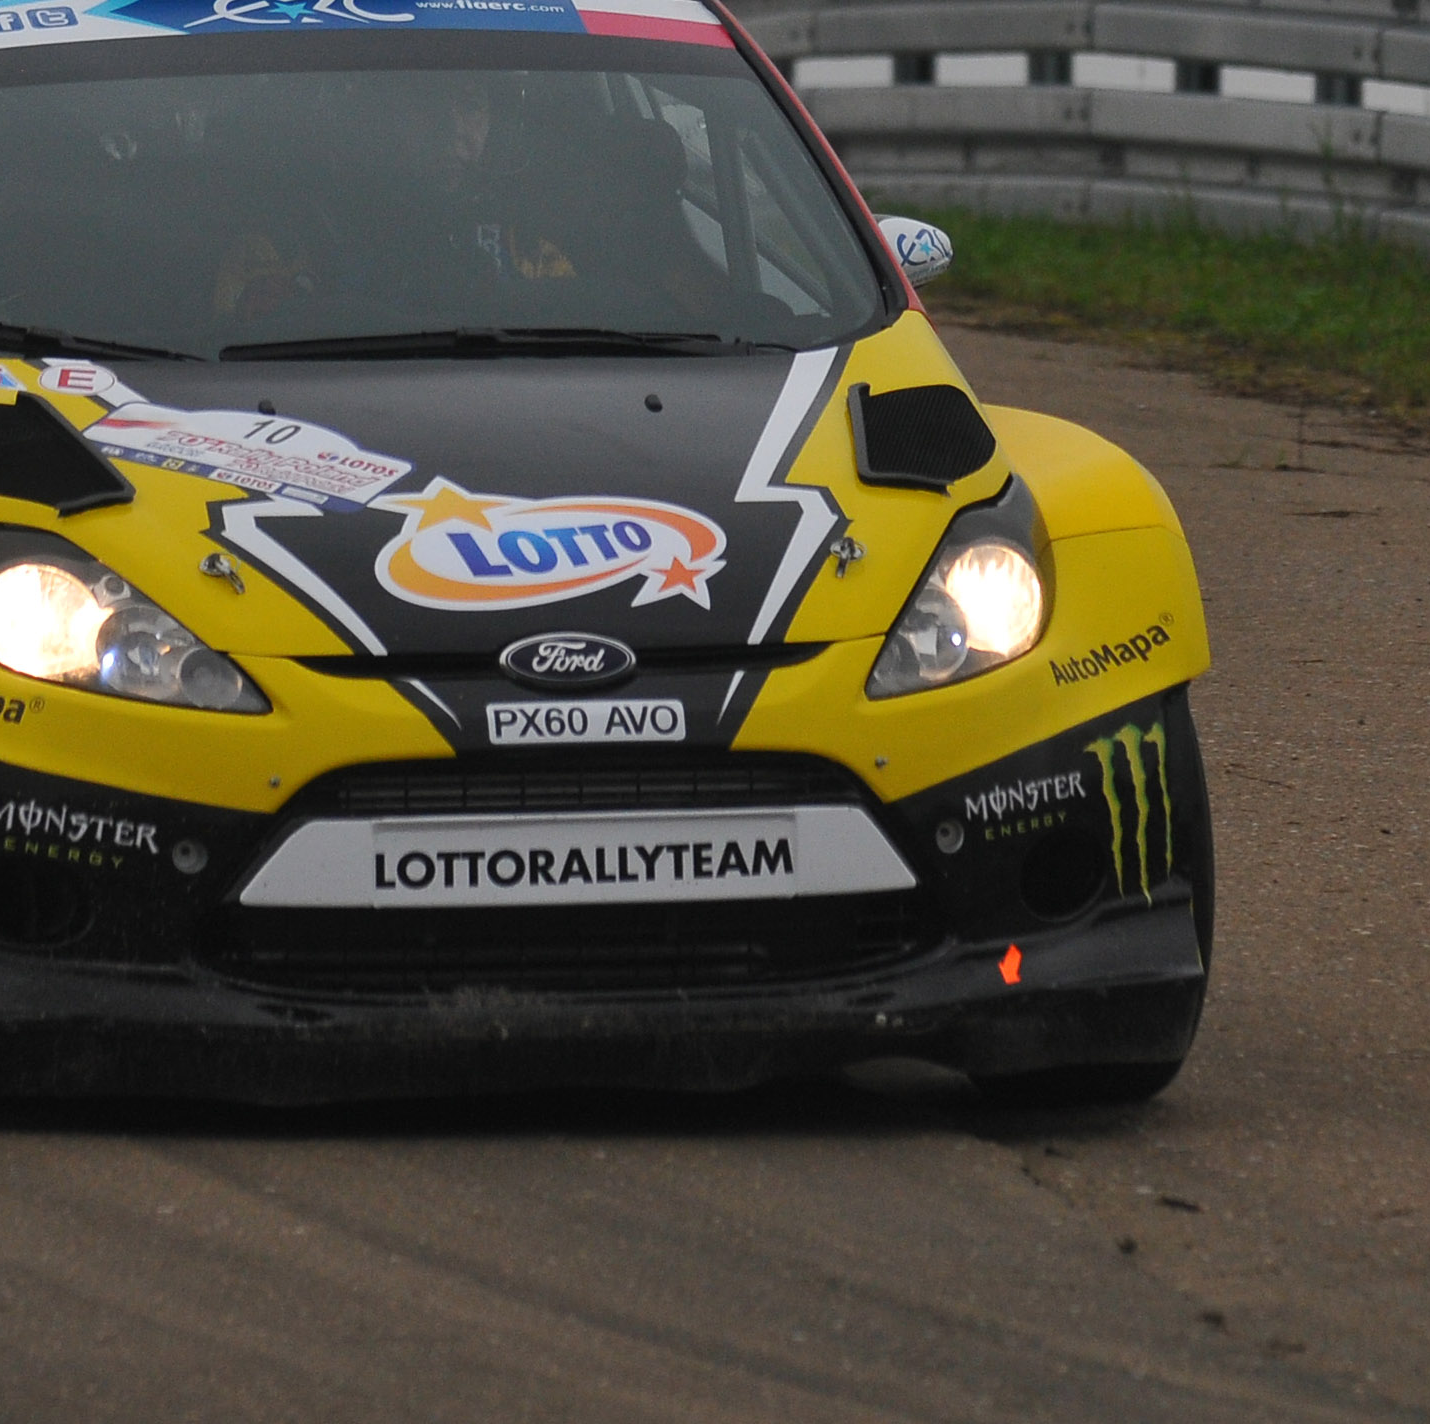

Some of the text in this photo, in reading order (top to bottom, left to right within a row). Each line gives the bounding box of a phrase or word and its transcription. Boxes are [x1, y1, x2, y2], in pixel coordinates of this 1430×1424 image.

[243, 420, 302, 446] 10
[339, 455, 400, 477] LOTOS
[446, 519, 652, 576] LOTTO
[532, 642, 605, 674] Ford
[493, 705, 679, 738] PX60 AVO
[3, 835, 125, 871] ENERGY
[374, 838, 795, 891] LOTTORALLYTEAM
